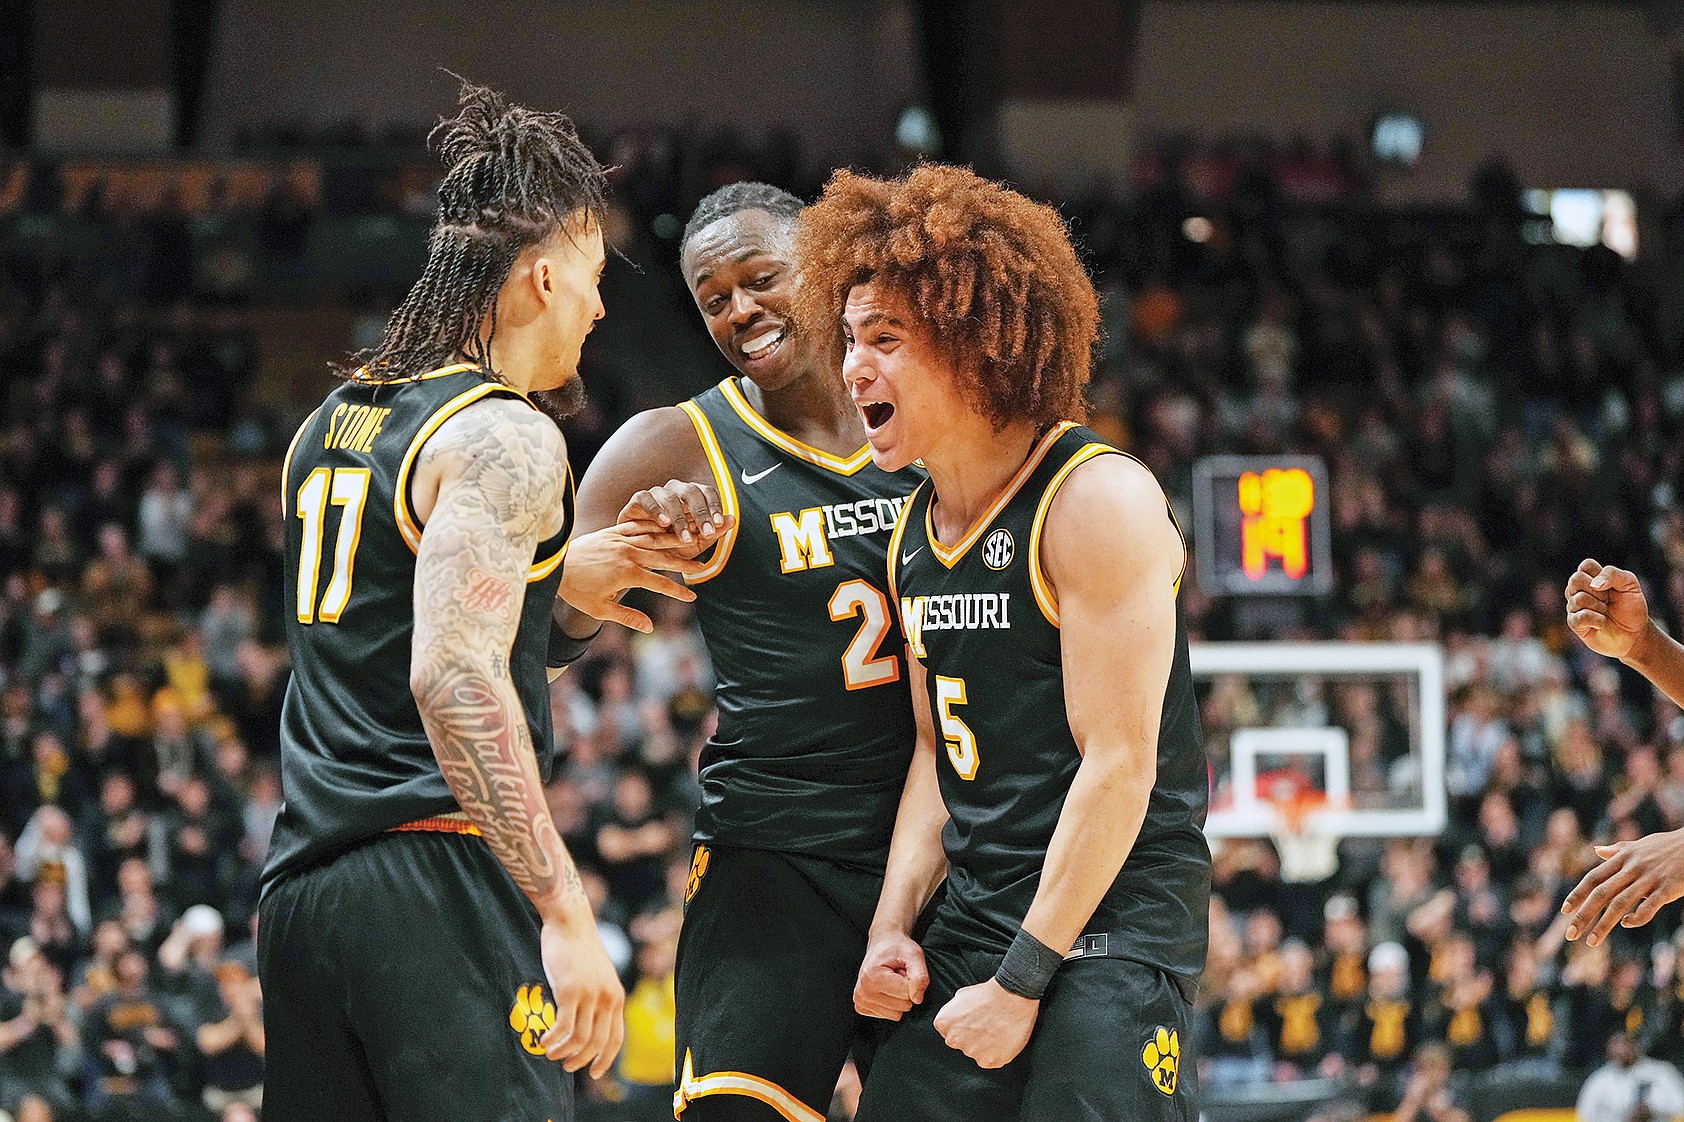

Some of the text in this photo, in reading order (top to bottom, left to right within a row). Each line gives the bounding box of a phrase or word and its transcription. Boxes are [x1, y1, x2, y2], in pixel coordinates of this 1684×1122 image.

[324, 402, 392, 453] STONE
[297, 467, 371, 625] 17
[983, 531, 1011, 567] SEC
[901, 593, 1011, 659] MISSOURI
[936, 675, 980, 781] 5
[432, 684, 553, 878] Walking
[1158, 1067, 1175, 1090] M
